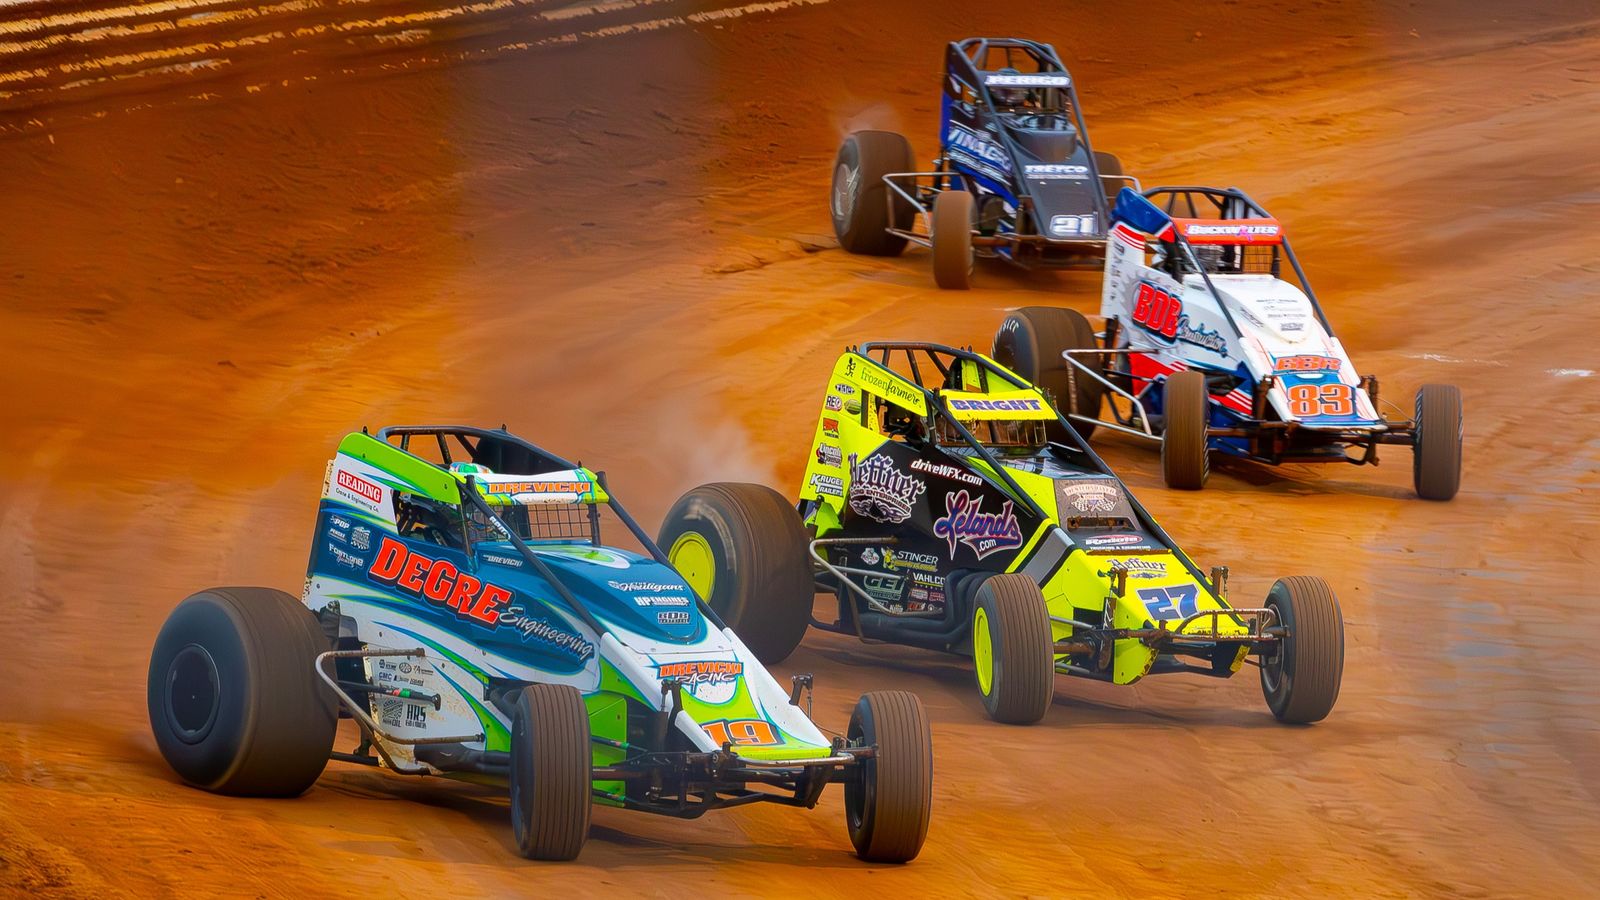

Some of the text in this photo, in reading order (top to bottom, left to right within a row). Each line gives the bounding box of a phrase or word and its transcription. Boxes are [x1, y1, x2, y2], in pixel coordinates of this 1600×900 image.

[1050, 213, 1098, 236] 21
[949, 399, 1042, 410] BRIGHT
[1287, 382, 1356, 417] 83
[911, 458, 983, 486] driveWFX.com
[338, 472, 381, 502] READING
[488, 482, 591, 494] DREVICKI
[933, 489, 1022, 561] Lelands
[897, 550, 939, 565] STINGER
[979, 539, 997, 552] .com
[369, 537, 512, 625] DEGRE
[1136, 583, 1201, 621] 27
[500, 606, 594, 660] Engineering
[660, 661, 742, 677] DREVICKI
[675, 672, 736, 691] RACING
[406, 704, 427, 721] HRS
[703, 720, 778, 747] 19
